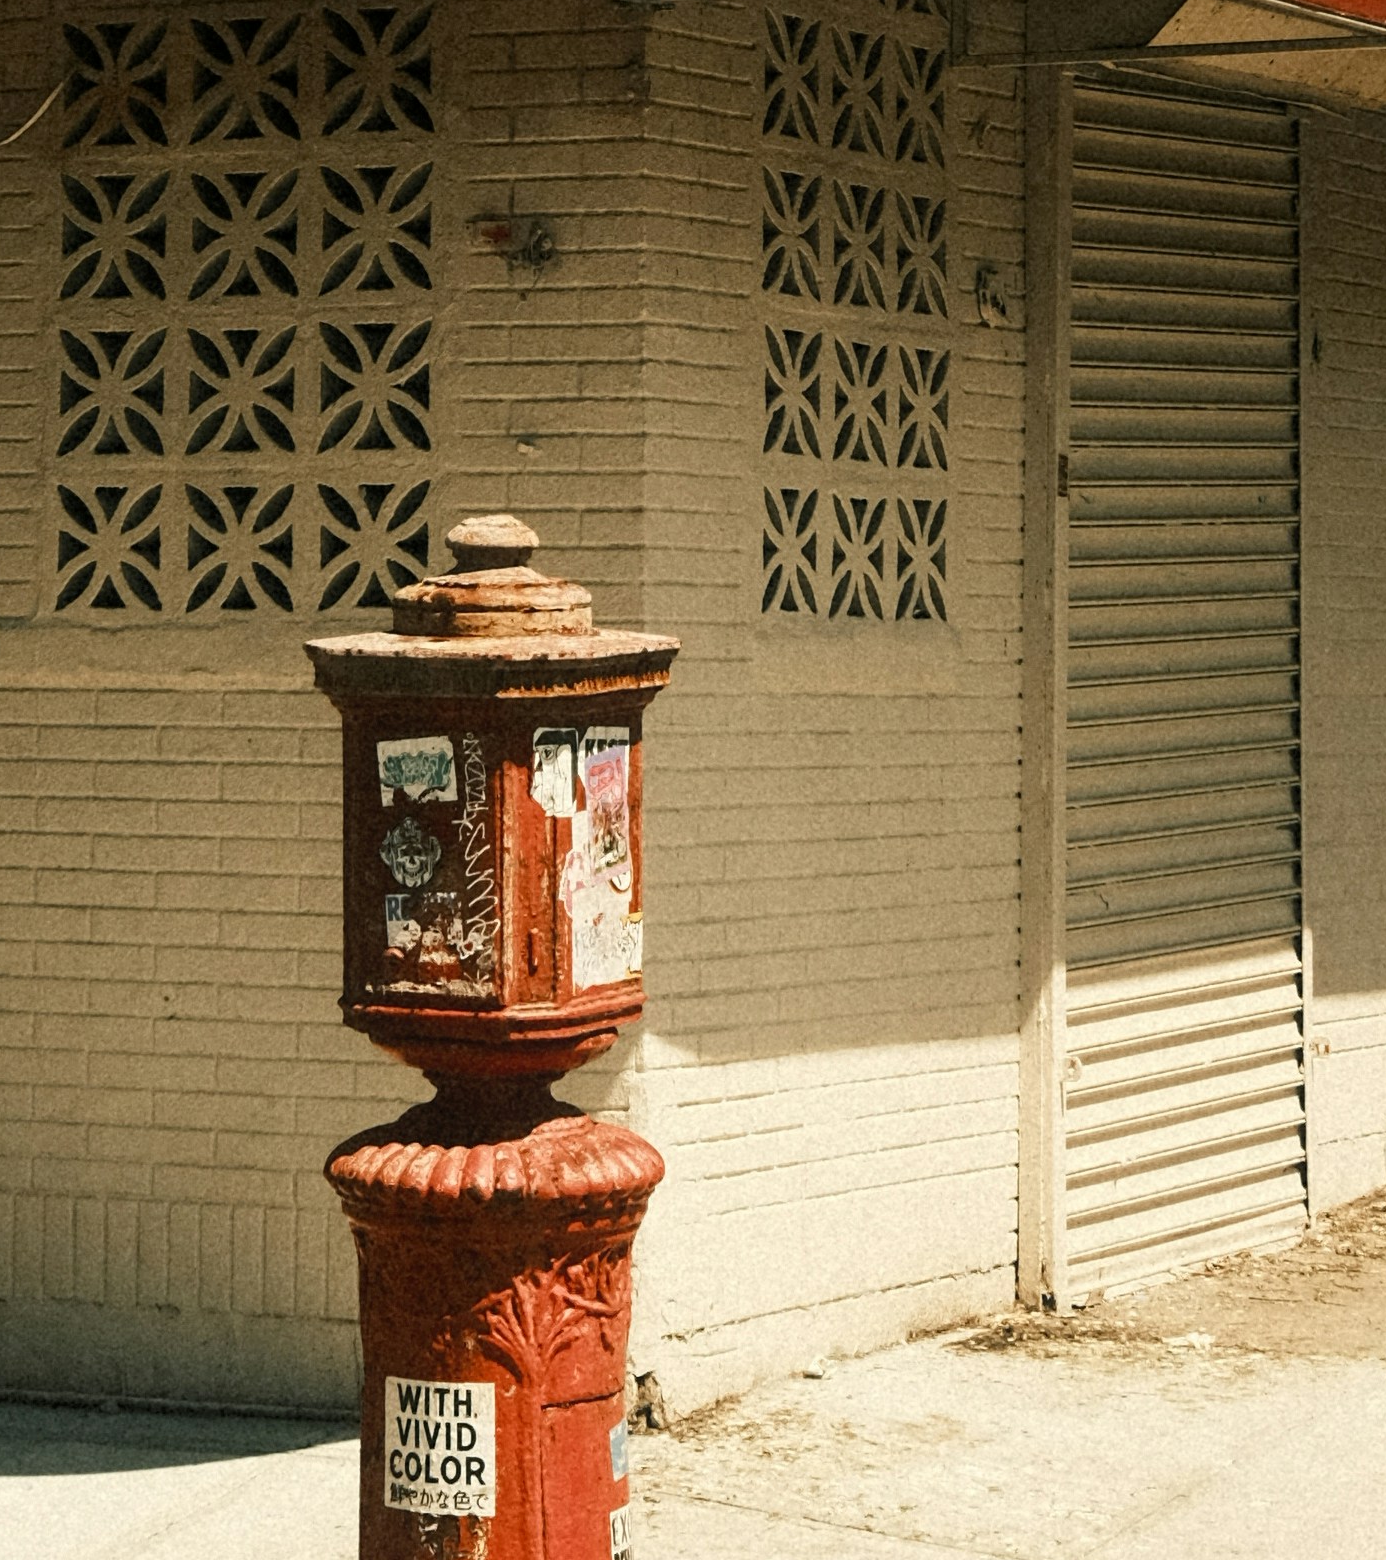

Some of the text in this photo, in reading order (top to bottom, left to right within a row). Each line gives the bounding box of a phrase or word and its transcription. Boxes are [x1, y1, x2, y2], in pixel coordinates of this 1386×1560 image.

[396, 1382, 472, 1418] WITH
[396, 1416, 477, 1452] VIVID
[389, 1449, 486, 1486] COLOR
